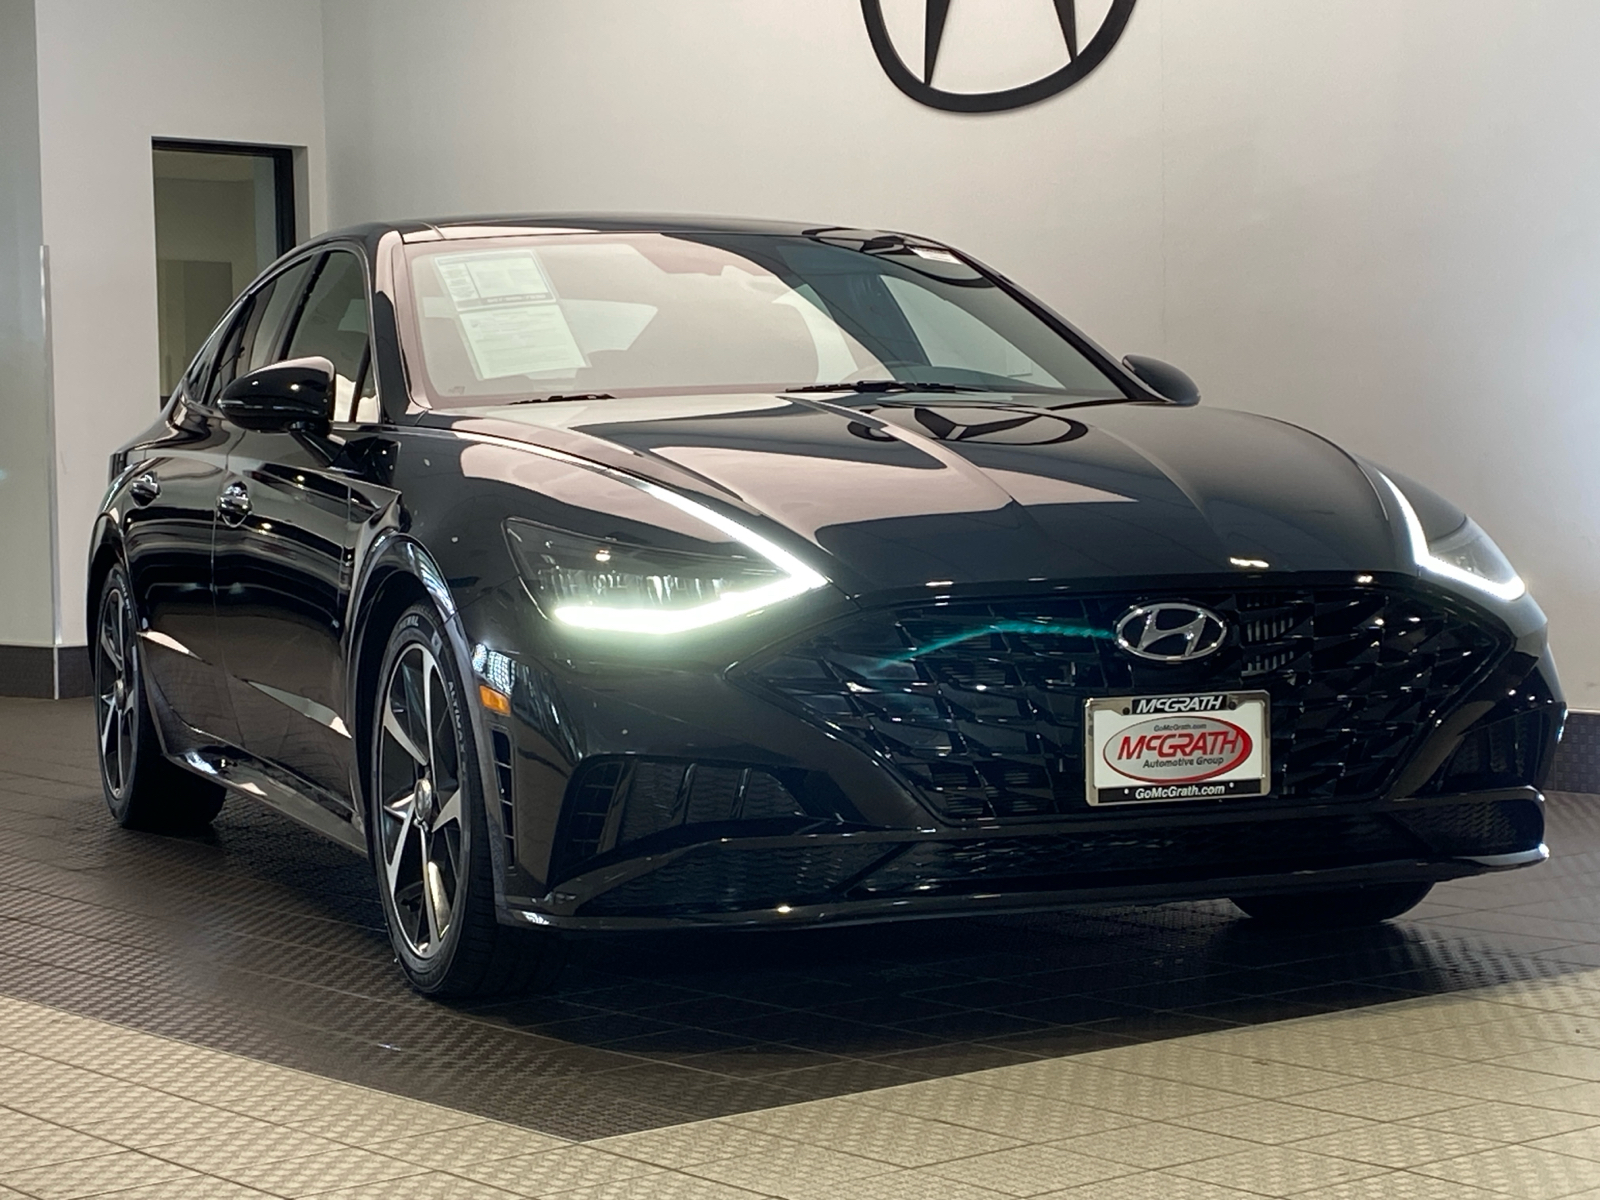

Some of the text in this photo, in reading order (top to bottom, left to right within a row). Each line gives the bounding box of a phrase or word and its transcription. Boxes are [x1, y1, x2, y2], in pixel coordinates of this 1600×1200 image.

[1153, 723, 1207, 732] GoMcGrath.com
[1142, 756, 1224, 769] Automotive Group
[1135, 784, 1226, 800] GoMcGrath.com
